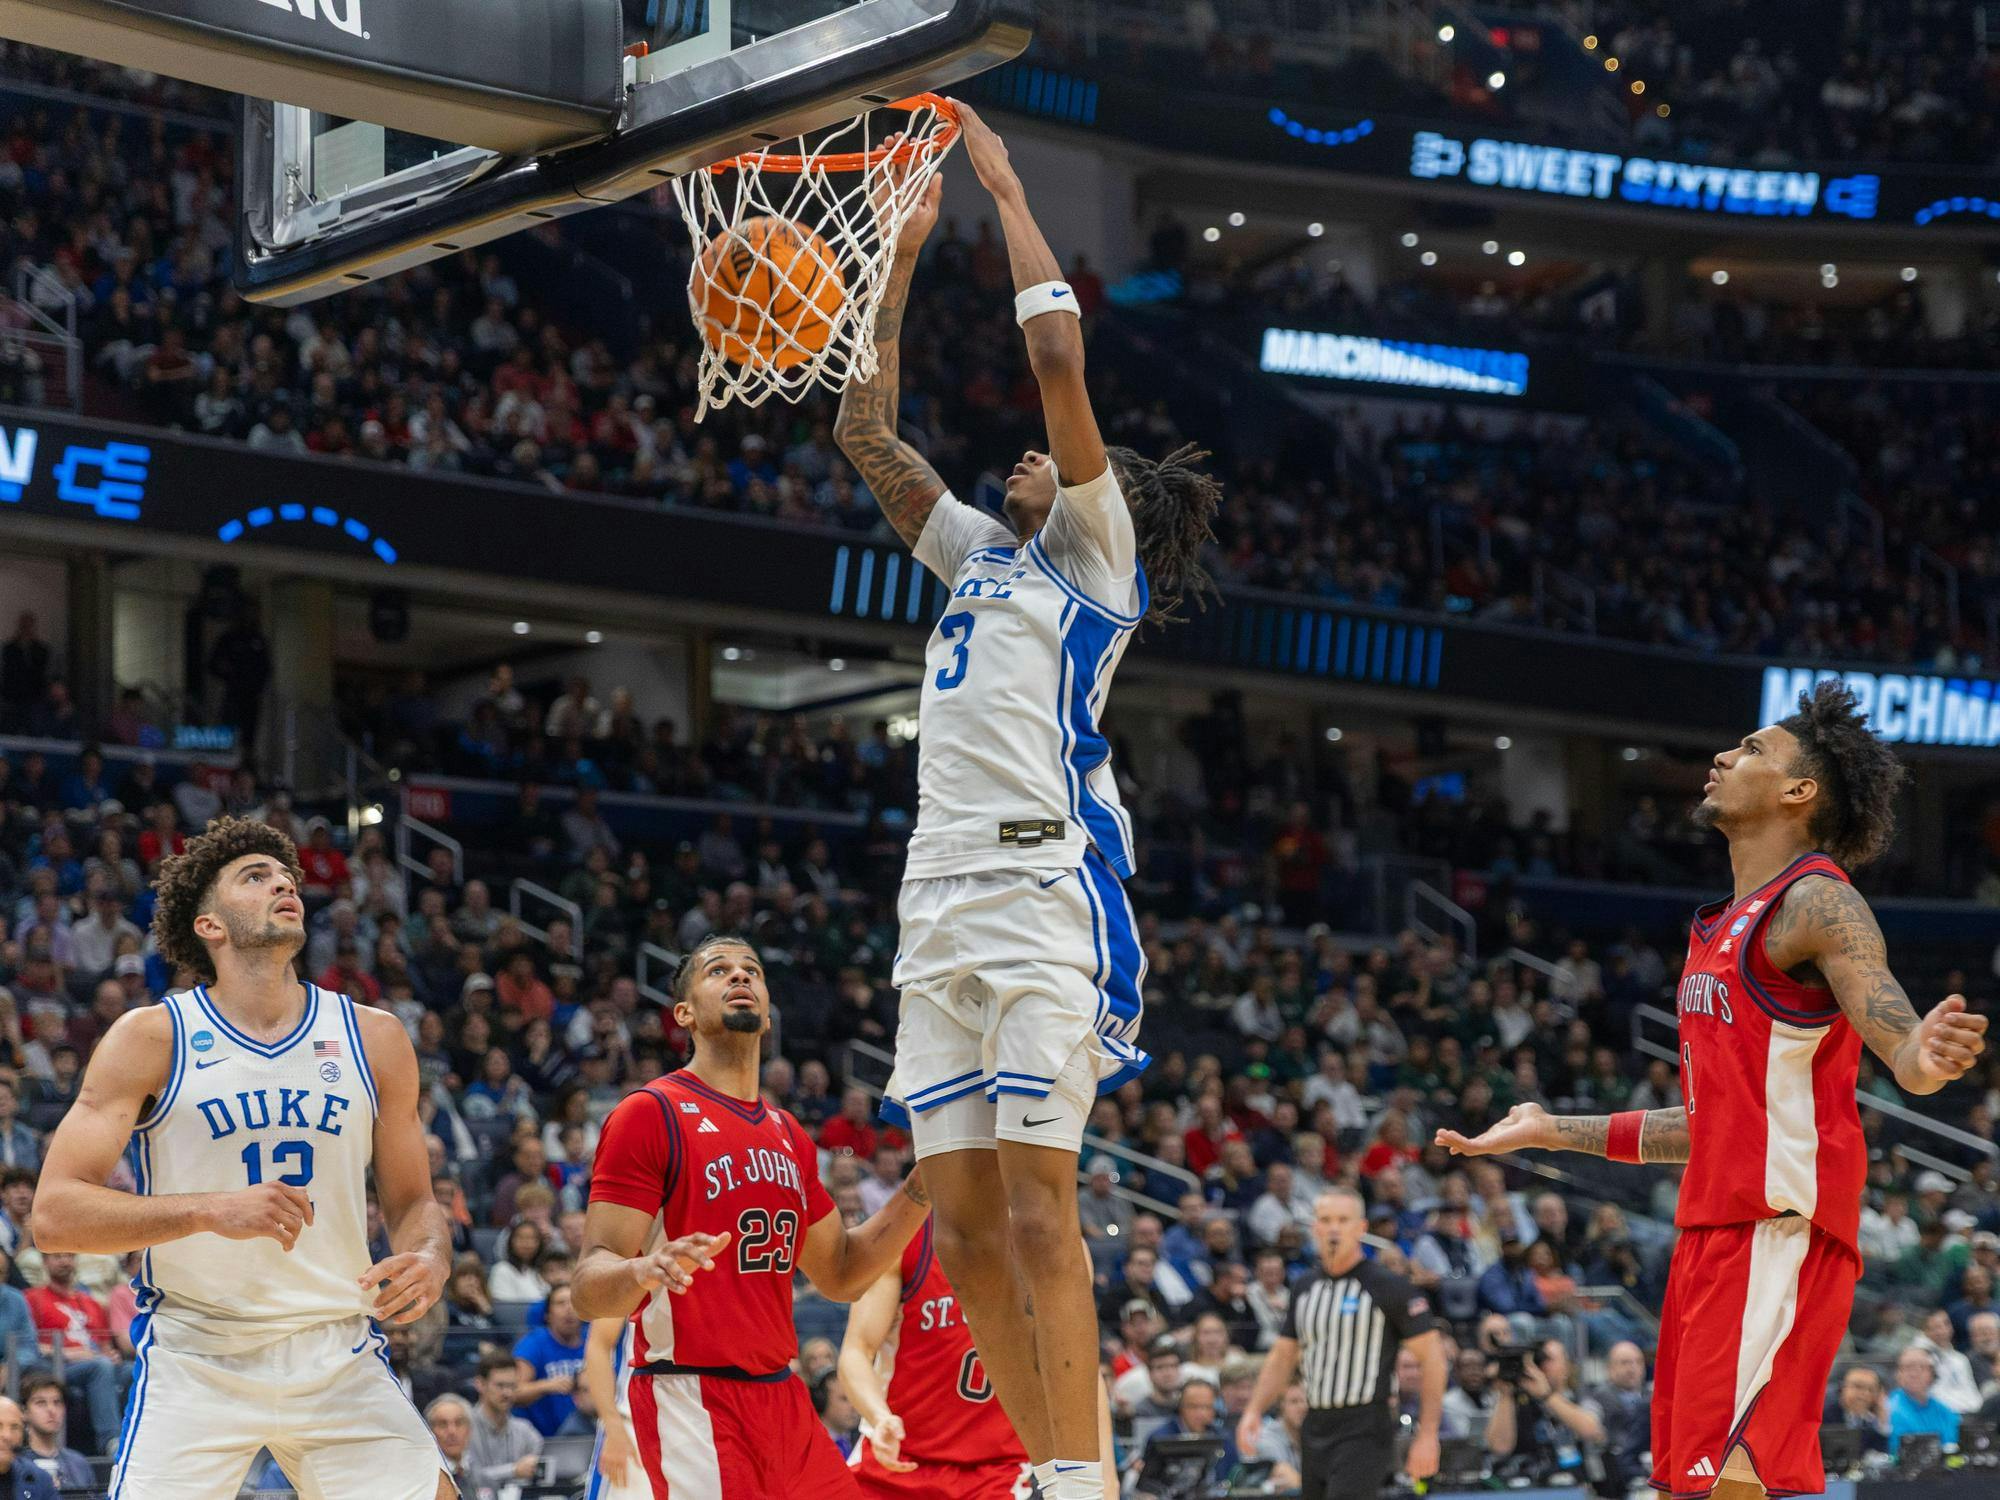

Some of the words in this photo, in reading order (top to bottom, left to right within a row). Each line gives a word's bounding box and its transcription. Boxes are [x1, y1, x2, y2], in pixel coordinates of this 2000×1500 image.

[1467, 138, 1621, 199] SWEET
[1621, 157, 1820, 217] SIXTEEN
[935, 611, 975, 691] 3
[196, 1088, 350, 1140] DUKE
[704, 1154, 742, 1201] ST.
[737, 1207, 799, 1274] 23
[920, 1296, 956, 1331] ST.
